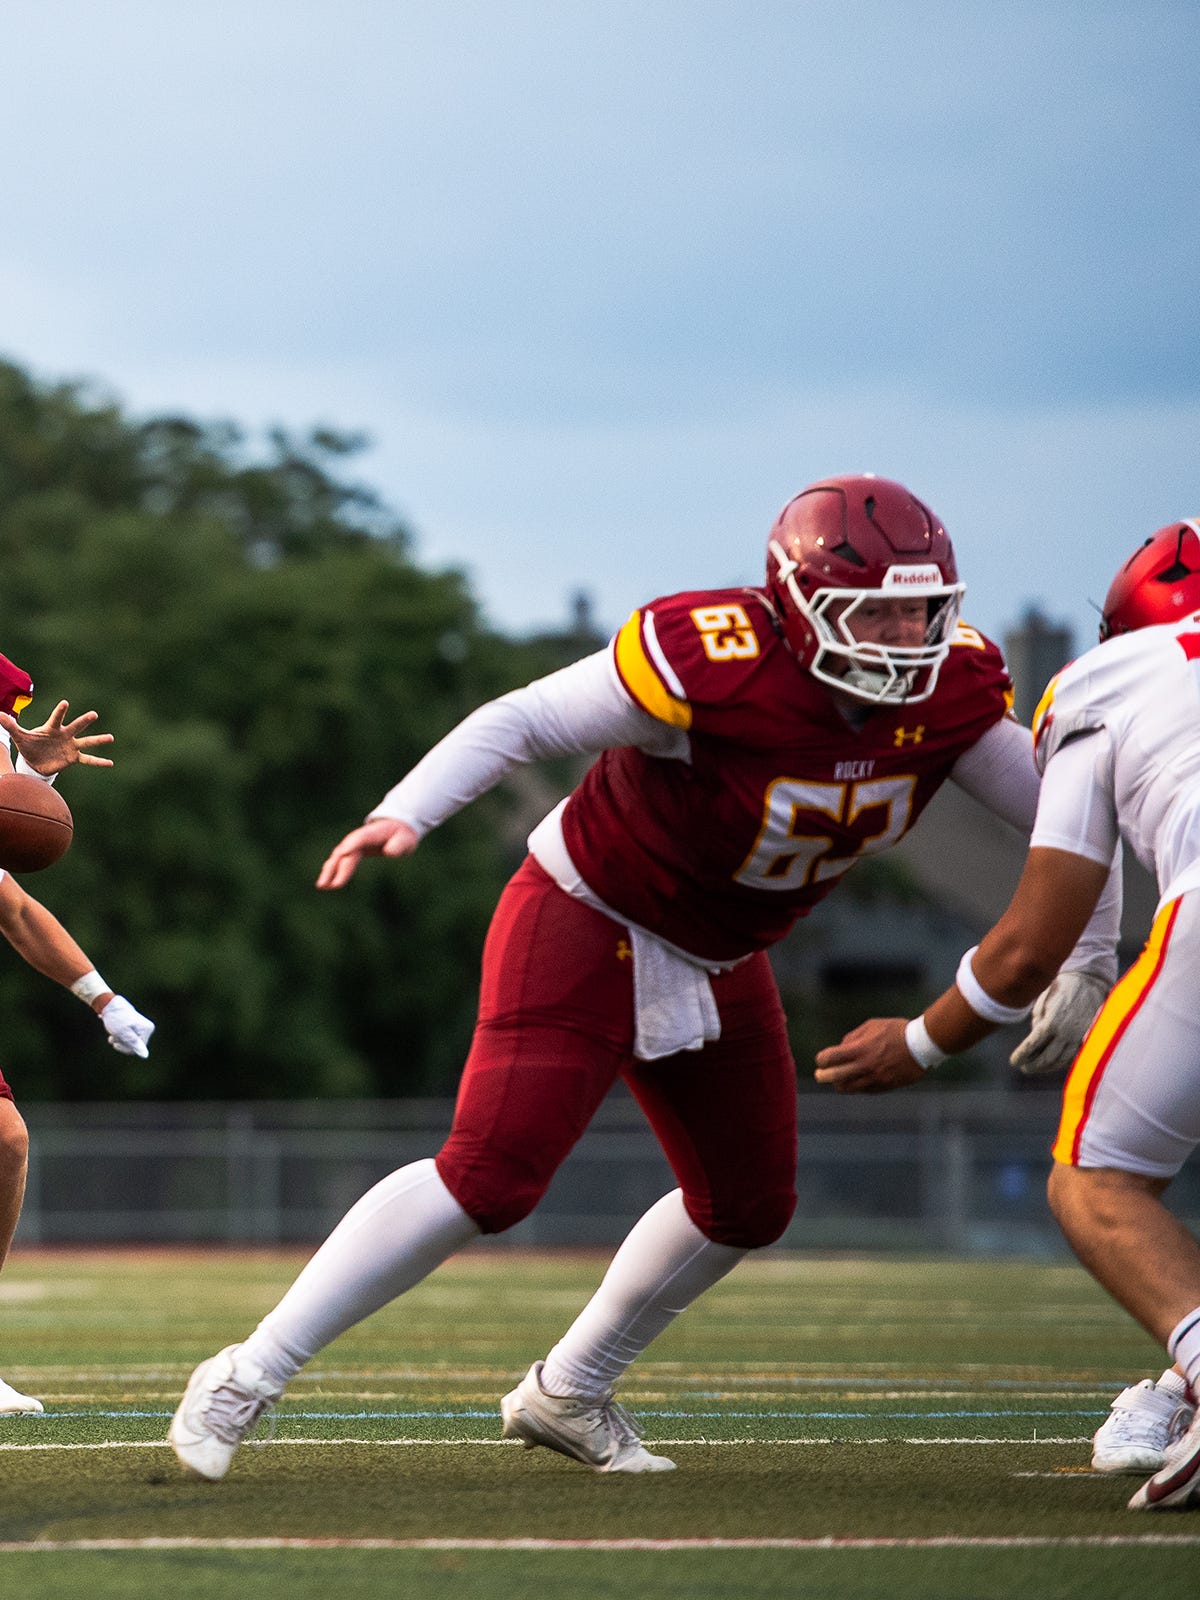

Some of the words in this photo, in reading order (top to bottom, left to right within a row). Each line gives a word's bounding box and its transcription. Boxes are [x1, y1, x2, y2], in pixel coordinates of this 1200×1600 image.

[892, 572, 940, 585] Riddell
[690, 603, 760, 662] 63
[833, 760, 876, 781] ROCKY
